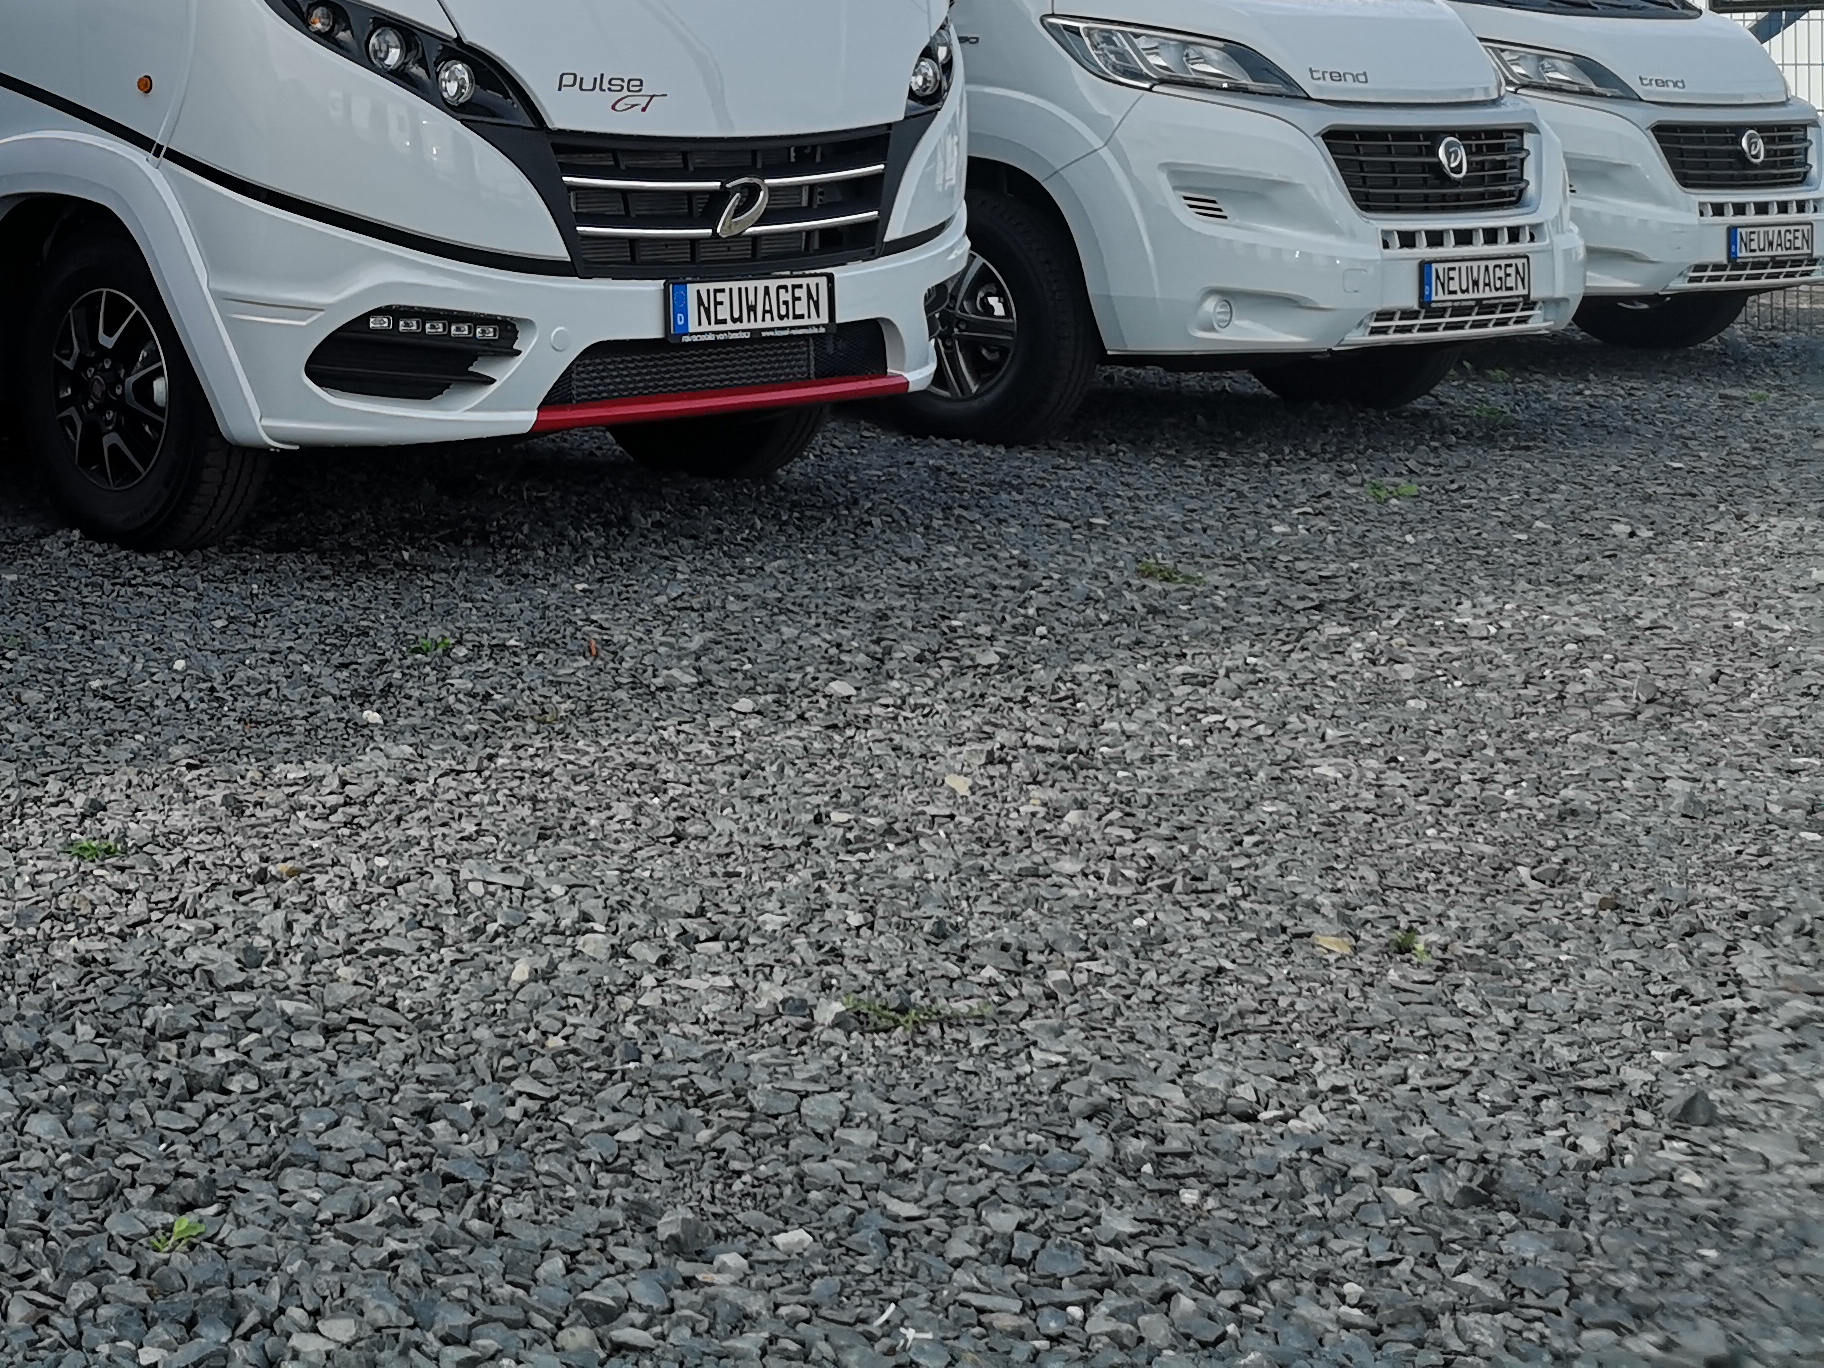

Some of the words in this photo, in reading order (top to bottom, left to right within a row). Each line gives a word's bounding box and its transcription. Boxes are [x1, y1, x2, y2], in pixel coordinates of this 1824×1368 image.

[557, 72, 644, 92] Pulse
[1308, 66, 1370, 84] trend
[1638, 75, 1686, 90] trend
[610, 93, 668, 113] GT
[1738, 228, 1811, 253] NEUWAGEN
[1434, 261, 1526, 297] NEUWAGEN
[676, 313, 685, 326] D
[695, 281, 821, 327] NEUWAGEN
